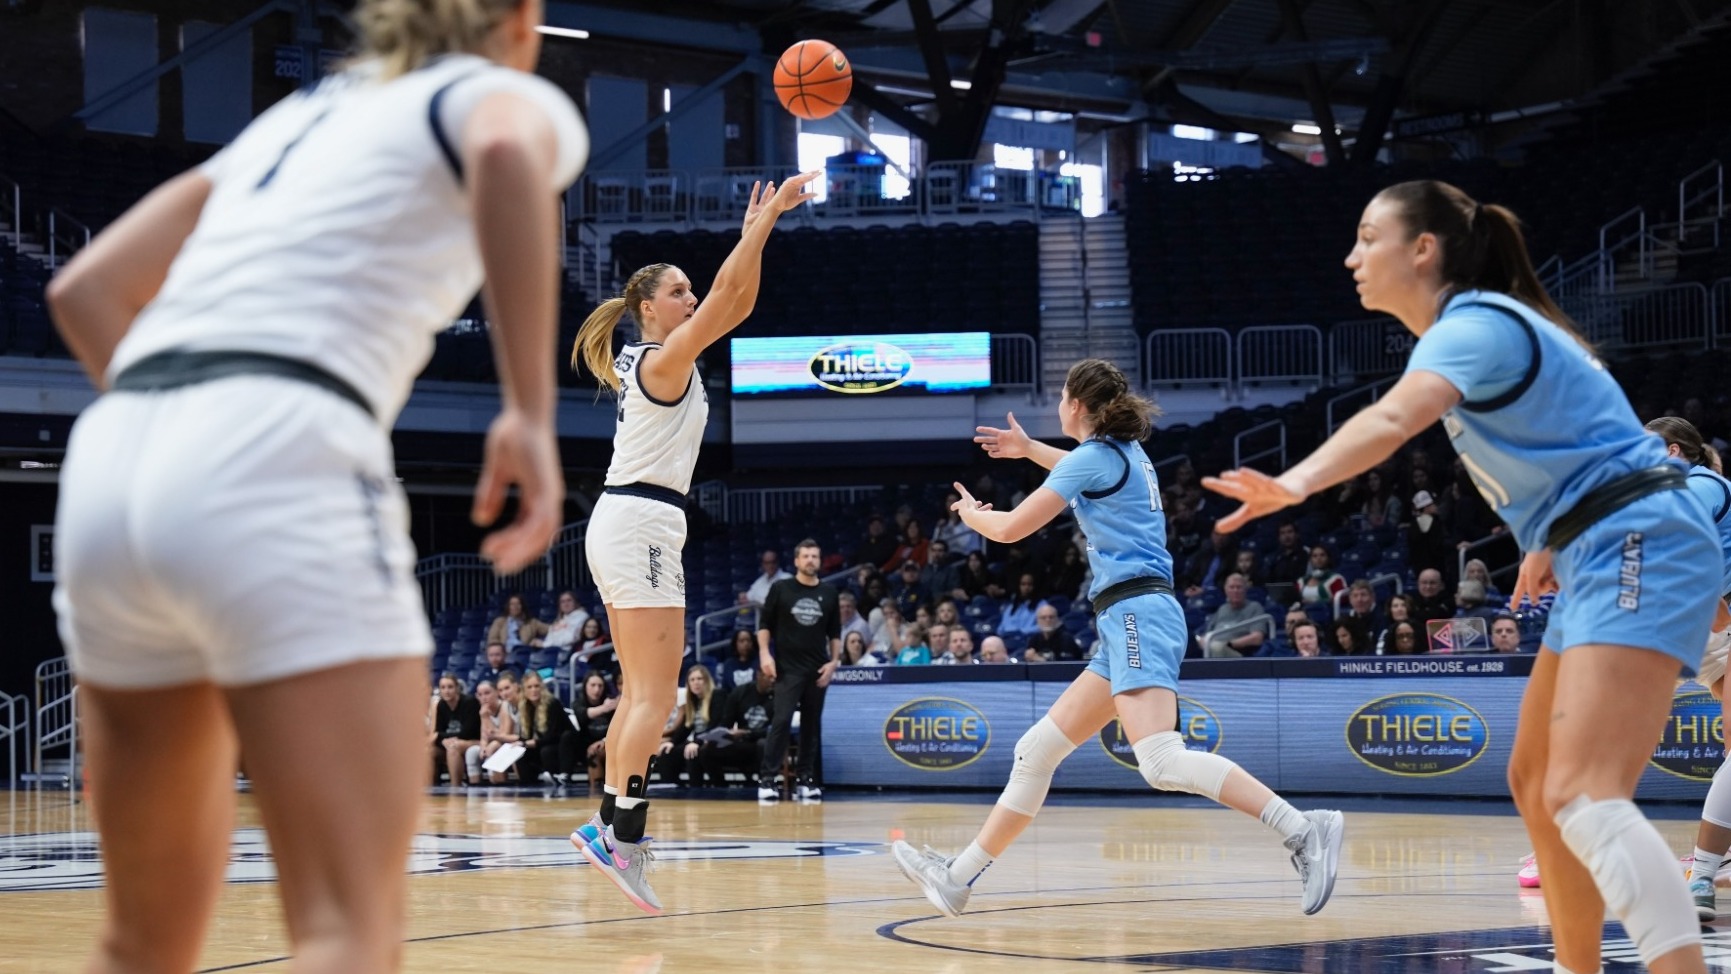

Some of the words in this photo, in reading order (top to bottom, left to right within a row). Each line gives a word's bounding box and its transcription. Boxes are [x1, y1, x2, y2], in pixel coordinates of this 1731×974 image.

[275, 60, 301, 77] 202
[817, 354, 903, 373] THIELE
[645, 544, 663, 589] Bulldogs
[1123, 613, 1141, 668] BLUEJAYS
[1340, 662, 1383, 673] HINKLE
[1386, 661, 1464, 673] FIELDHOUSE
[1481, 661, 1504, 673] 1928
[893, 716, 979, 740] THIELE
[1358, 714, 1473, 741] THIELE
[1361, 743, 1394, 756] Heating
[1406, 744, 1419, 755] Air
[1420, 744, 1472, 757] Conditioning
